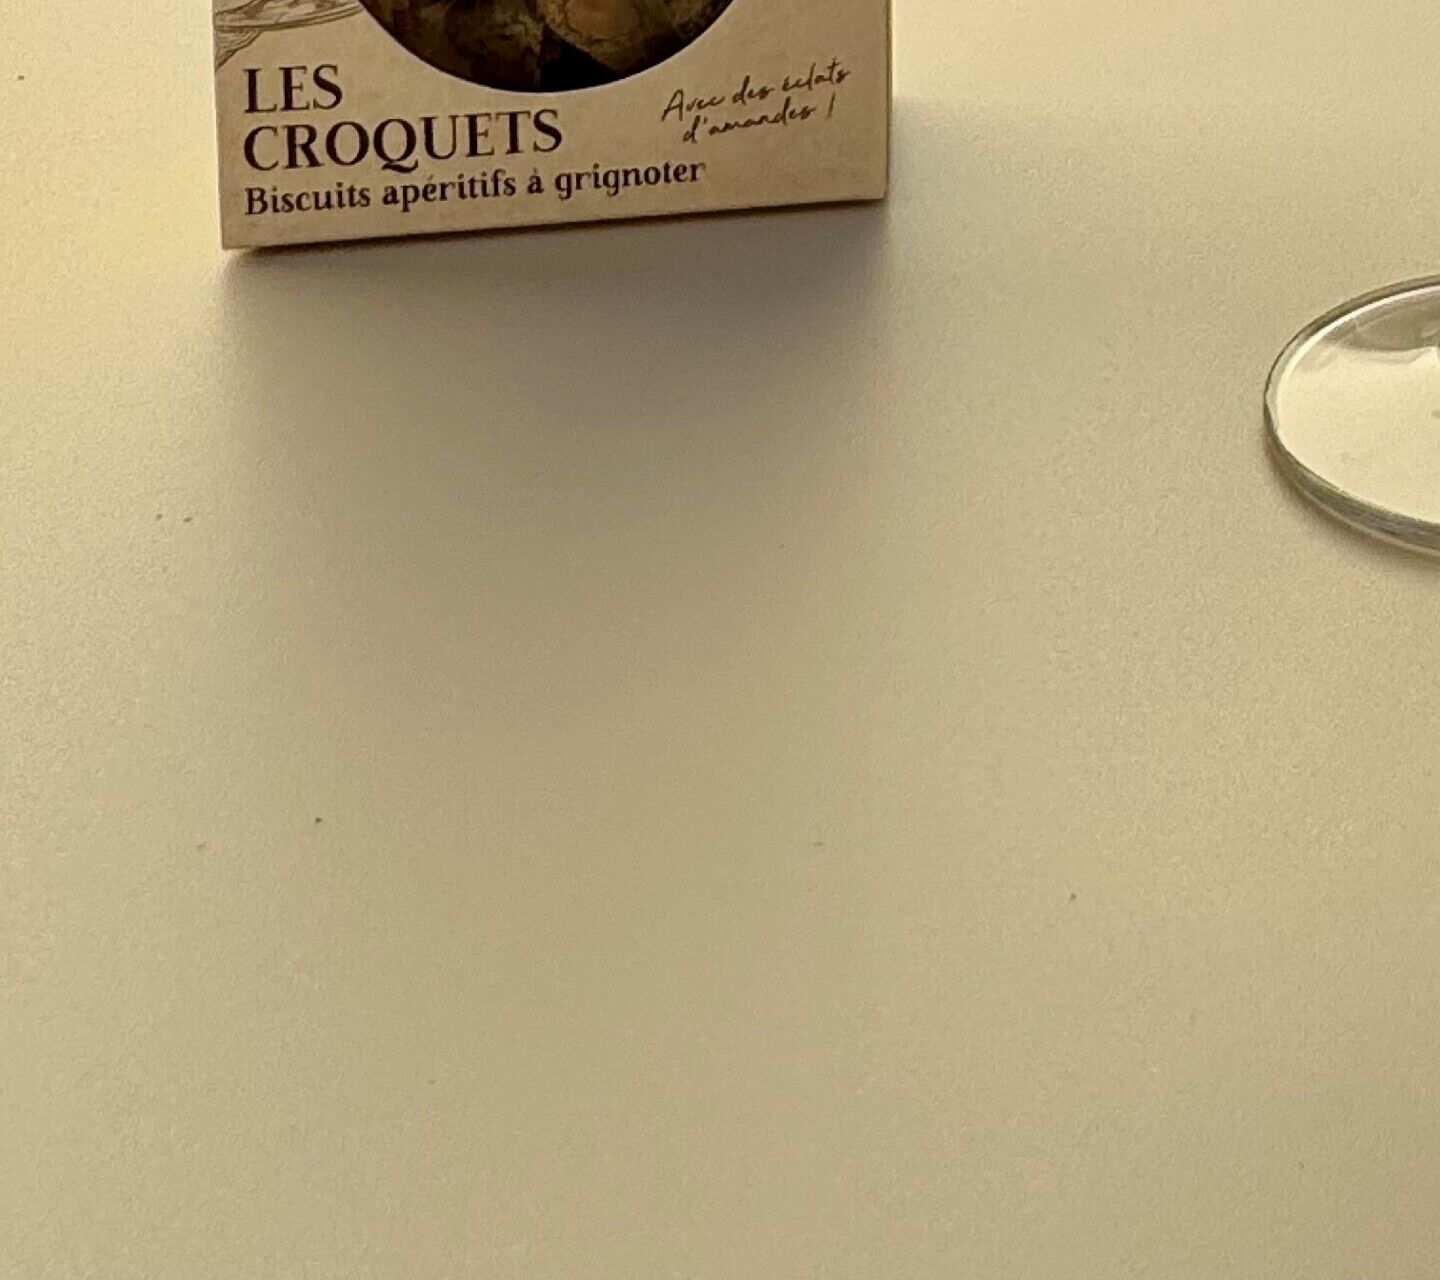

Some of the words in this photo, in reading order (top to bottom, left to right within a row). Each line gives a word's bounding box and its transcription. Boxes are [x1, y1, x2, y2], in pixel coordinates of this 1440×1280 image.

[243, 63, 344, 114] LES
[661, 88, 725, 122] Avec
[732, 75, 776, 106] des
[243, 109, 563, 174] CROQUETS
[244, 181, 372, 216] Biscuits
[381, 168, 517, 212] apéritifs
[526, 166, 544, 196] à
[555, 160, 706, 202] grignoter
